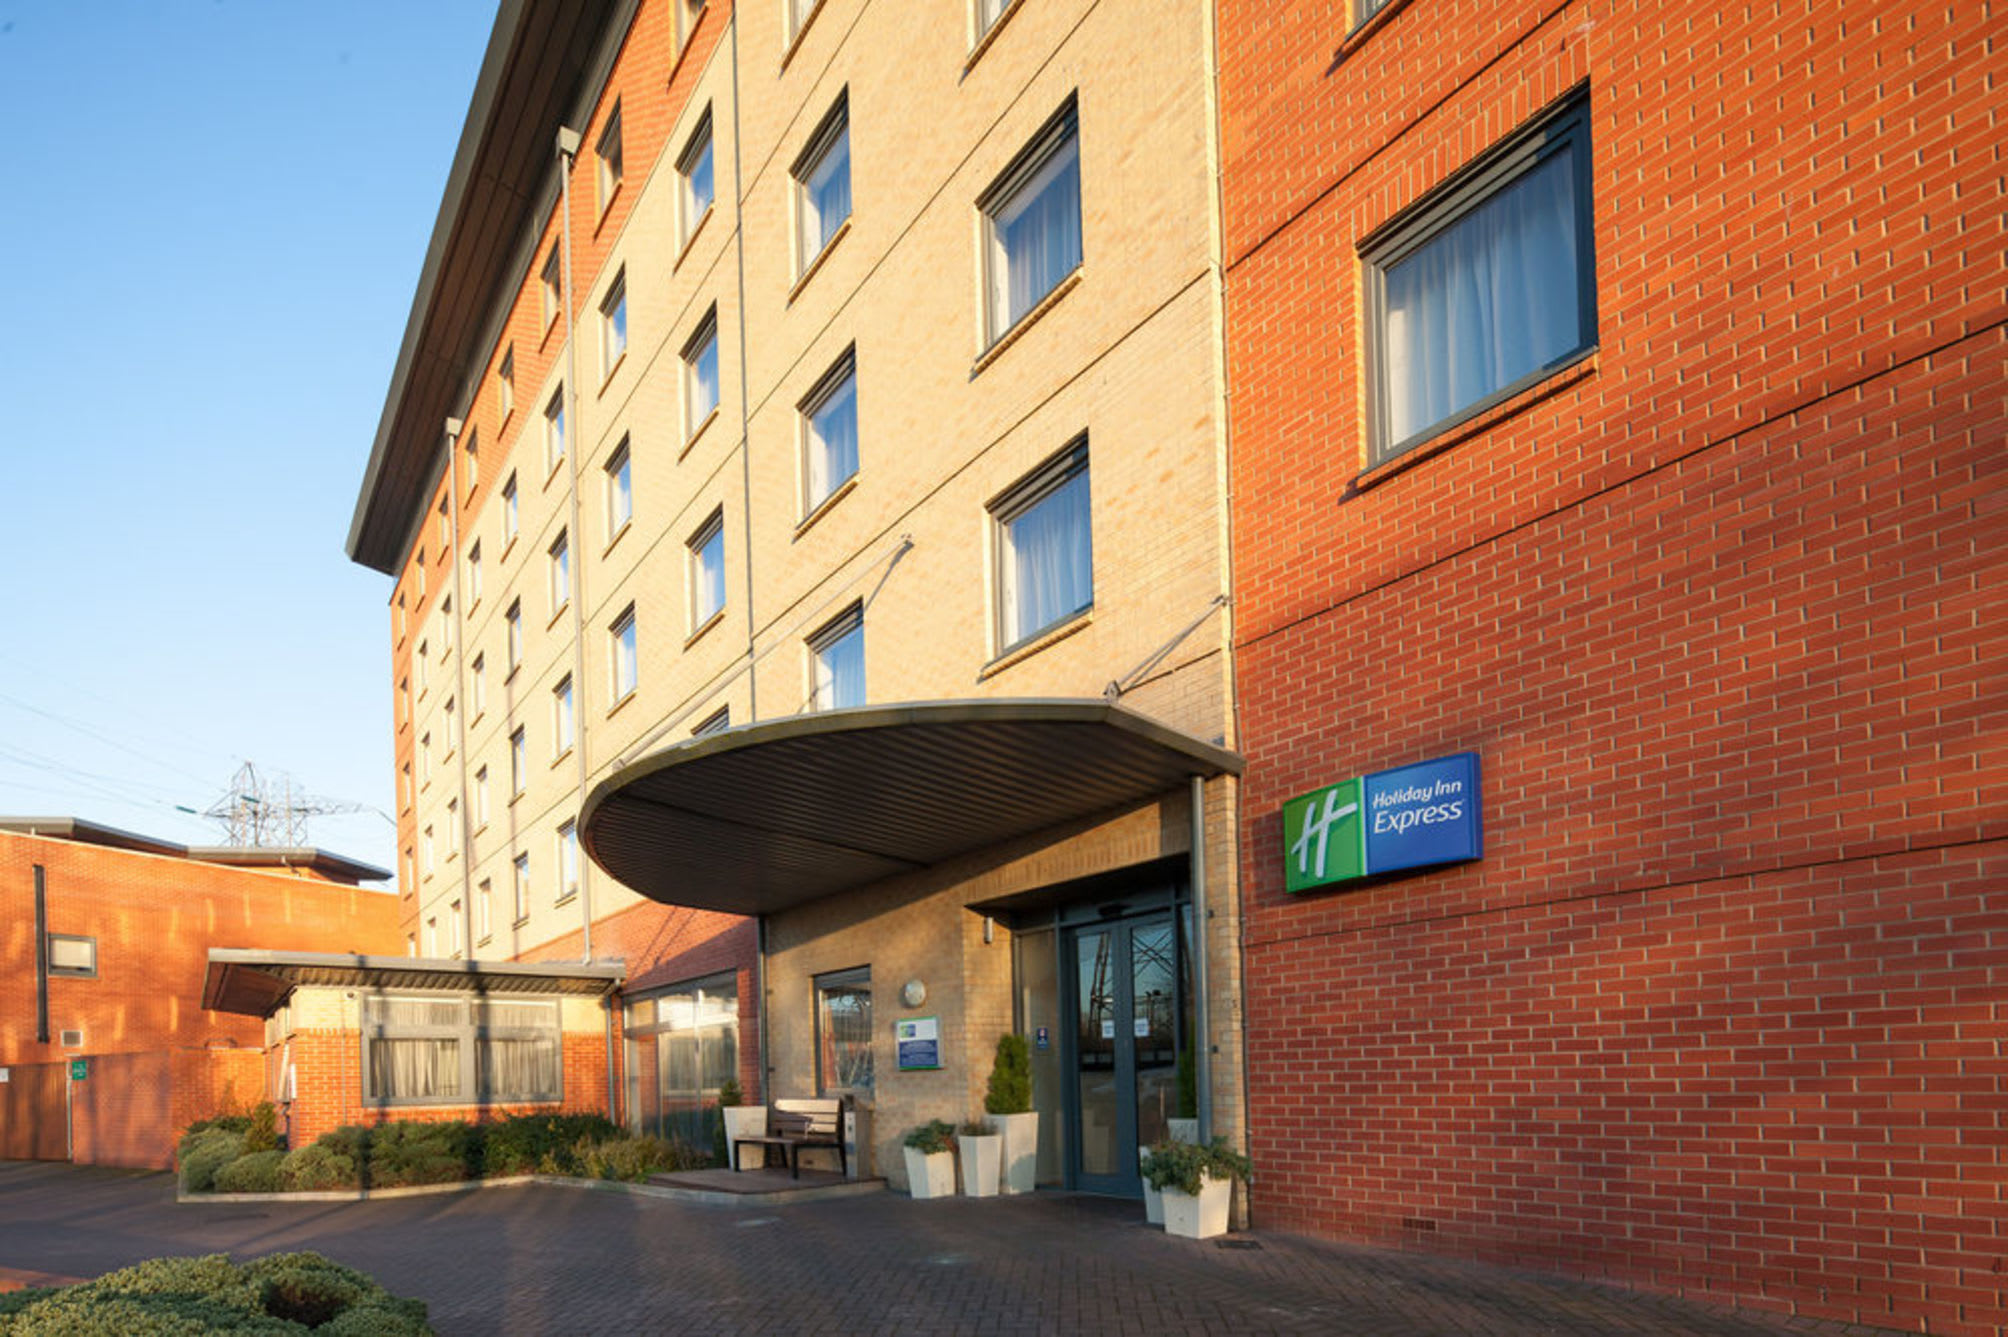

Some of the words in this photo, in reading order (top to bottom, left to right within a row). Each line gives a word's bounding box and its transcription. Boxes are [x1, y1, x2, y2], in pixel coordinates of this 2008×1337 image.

[1372, 786, 1433, 809] Holiday
[1435, 779, 1462, 797] Inn
[1374, 801, 1463, 834] Express
